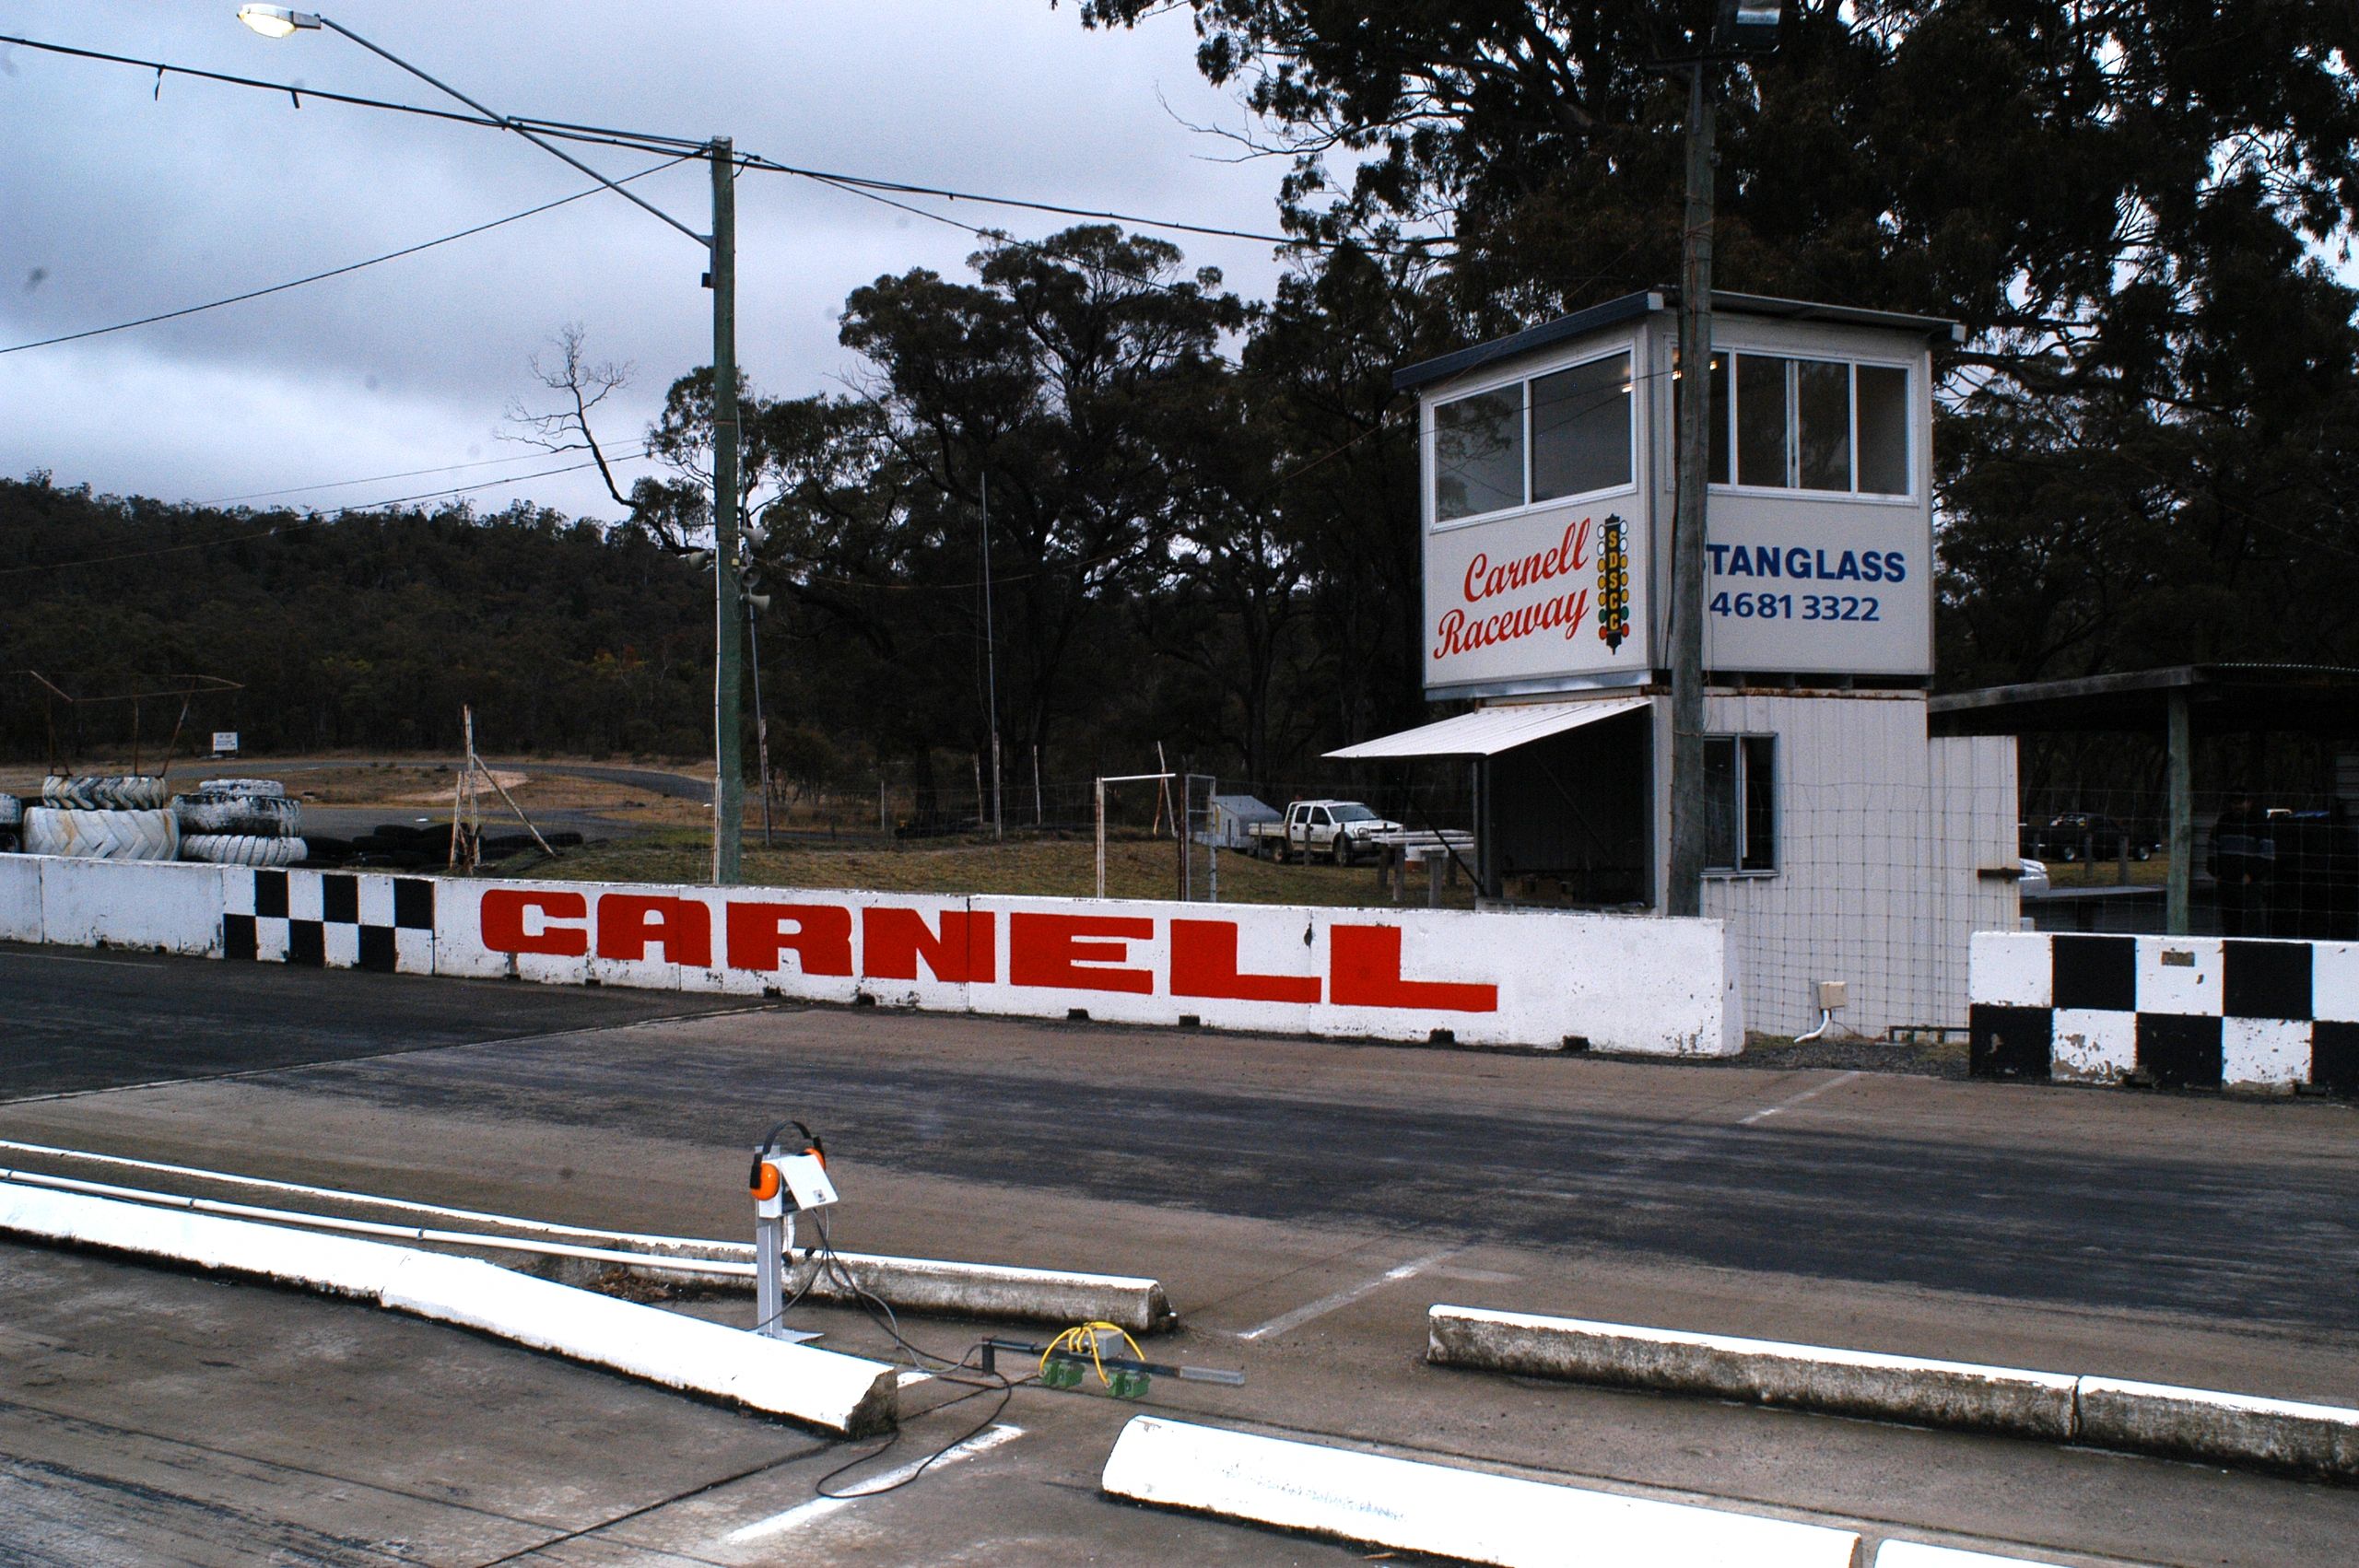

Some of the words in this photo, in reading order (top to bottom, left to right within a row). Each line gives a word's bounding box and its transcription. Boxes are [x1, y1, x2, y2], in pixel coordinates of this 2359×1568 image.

[1463, 517, 1590, 603] Carnell
[1608, 530, 1619, 630] SDSCC
[1703, 544, 1906, 582] TANGLASS
[1433, 588, 1590, 660] Raceway
[1709, 591, 1791, 618] 4681
[1802, 595, 1880, 621] 3322
[480, 889, 1496, 1012] CARNELL
